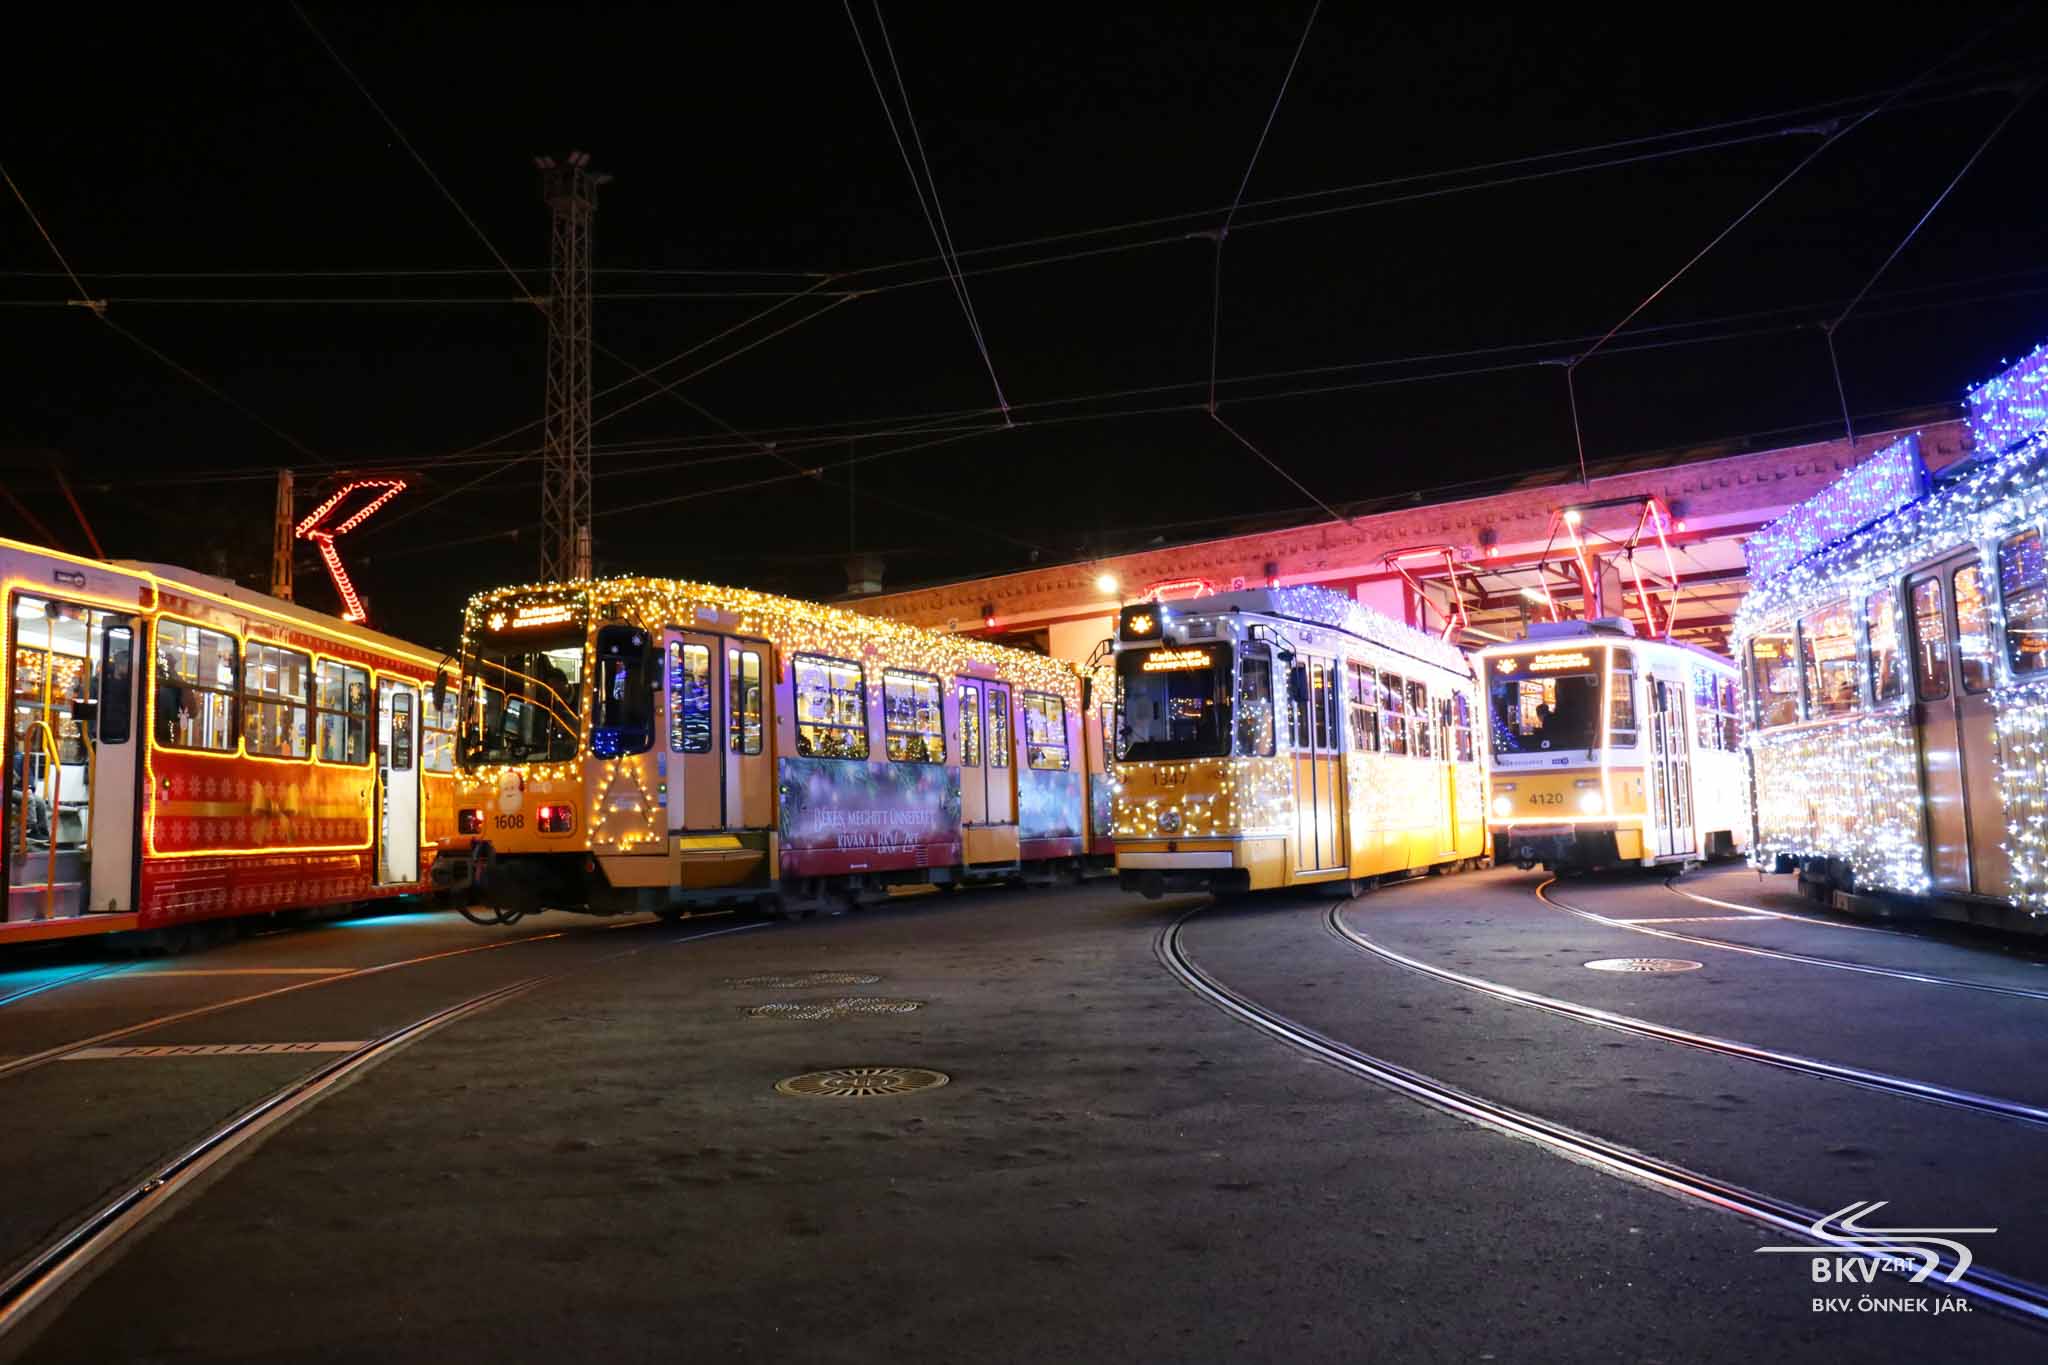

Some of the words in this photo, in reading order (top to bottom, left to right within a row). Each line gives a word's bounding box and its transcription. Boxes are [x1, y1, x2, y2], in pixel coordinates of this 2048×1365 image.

[1151, 772, 1188, 786] 1347
[1529, 792, 1564, 805] 4120
[493, 814, 525, 829] 1608
